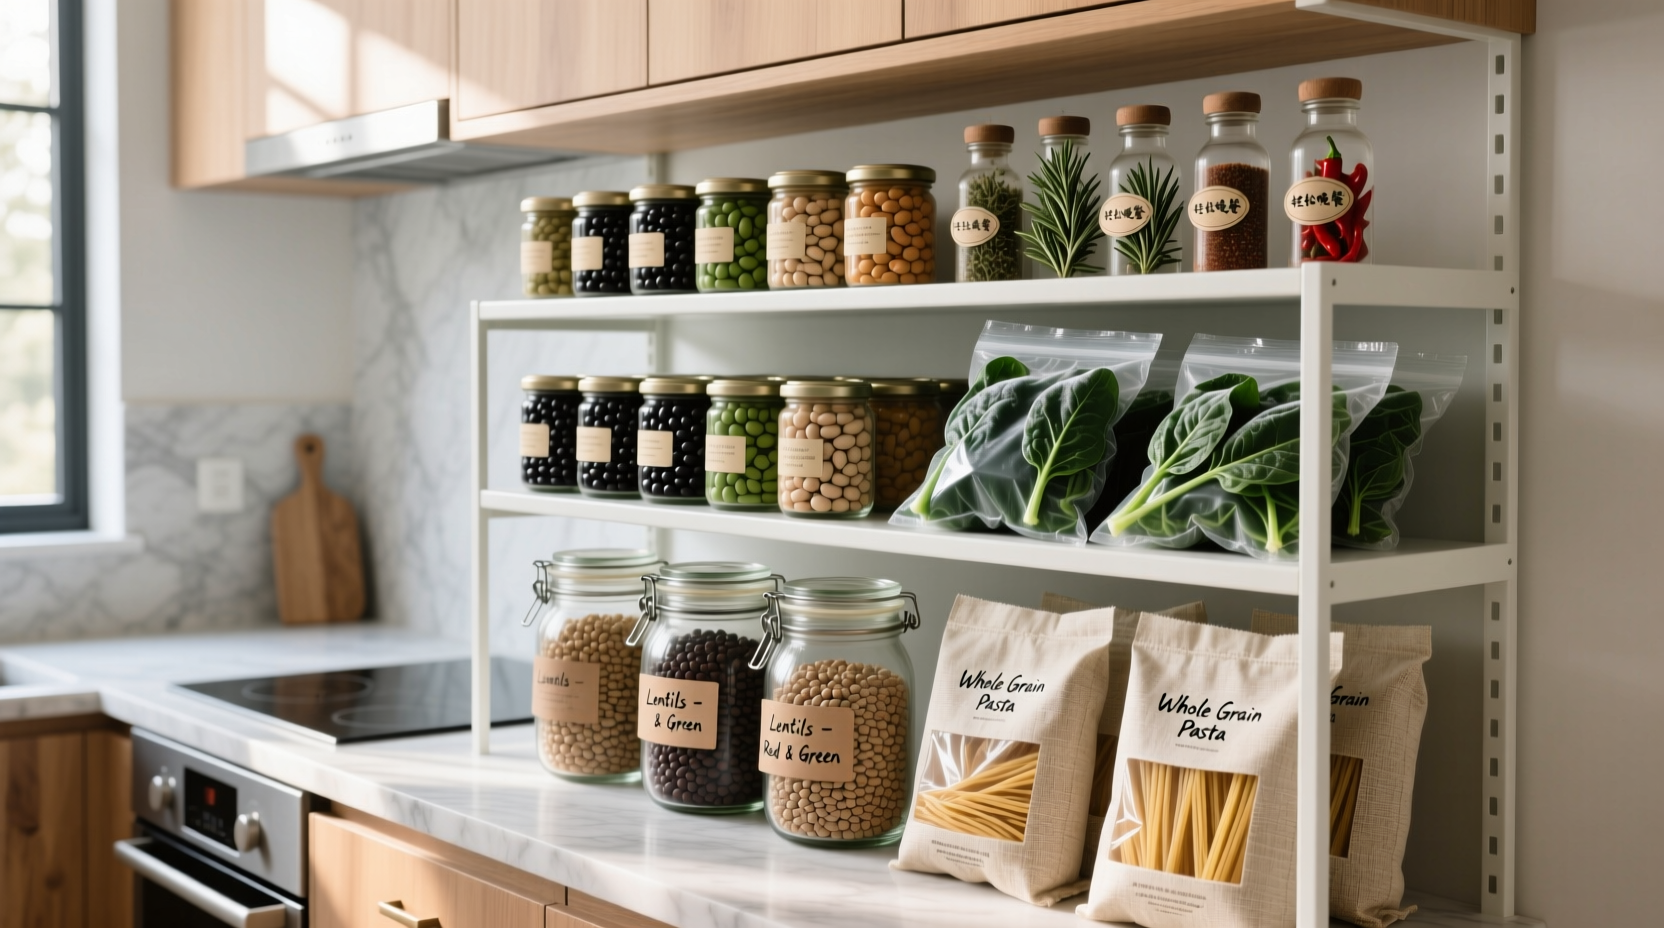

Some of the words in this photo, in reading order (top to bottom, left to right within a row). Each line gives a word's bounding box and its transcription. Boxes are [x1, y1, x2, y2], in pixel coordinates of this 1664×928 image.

[959, 669, 1004, 691] Whole
[1007, 674, 1045, 693] Grain
[646, 688, 687, 709] Lentils
[975, 693, 1015, 713] Pasta
[1158, 692, 1211, 718] Whole
[1216, 701, 1262, 722] Grain
[654, 713, 661, 728] &
[666, 713, 702, 733] Green
[769, 713, 813, 737] Lentils
[1177, 719, 1226, 742] Pasta
[785, 744, 793, 761] &
[798, 744, 841, 765] Green
